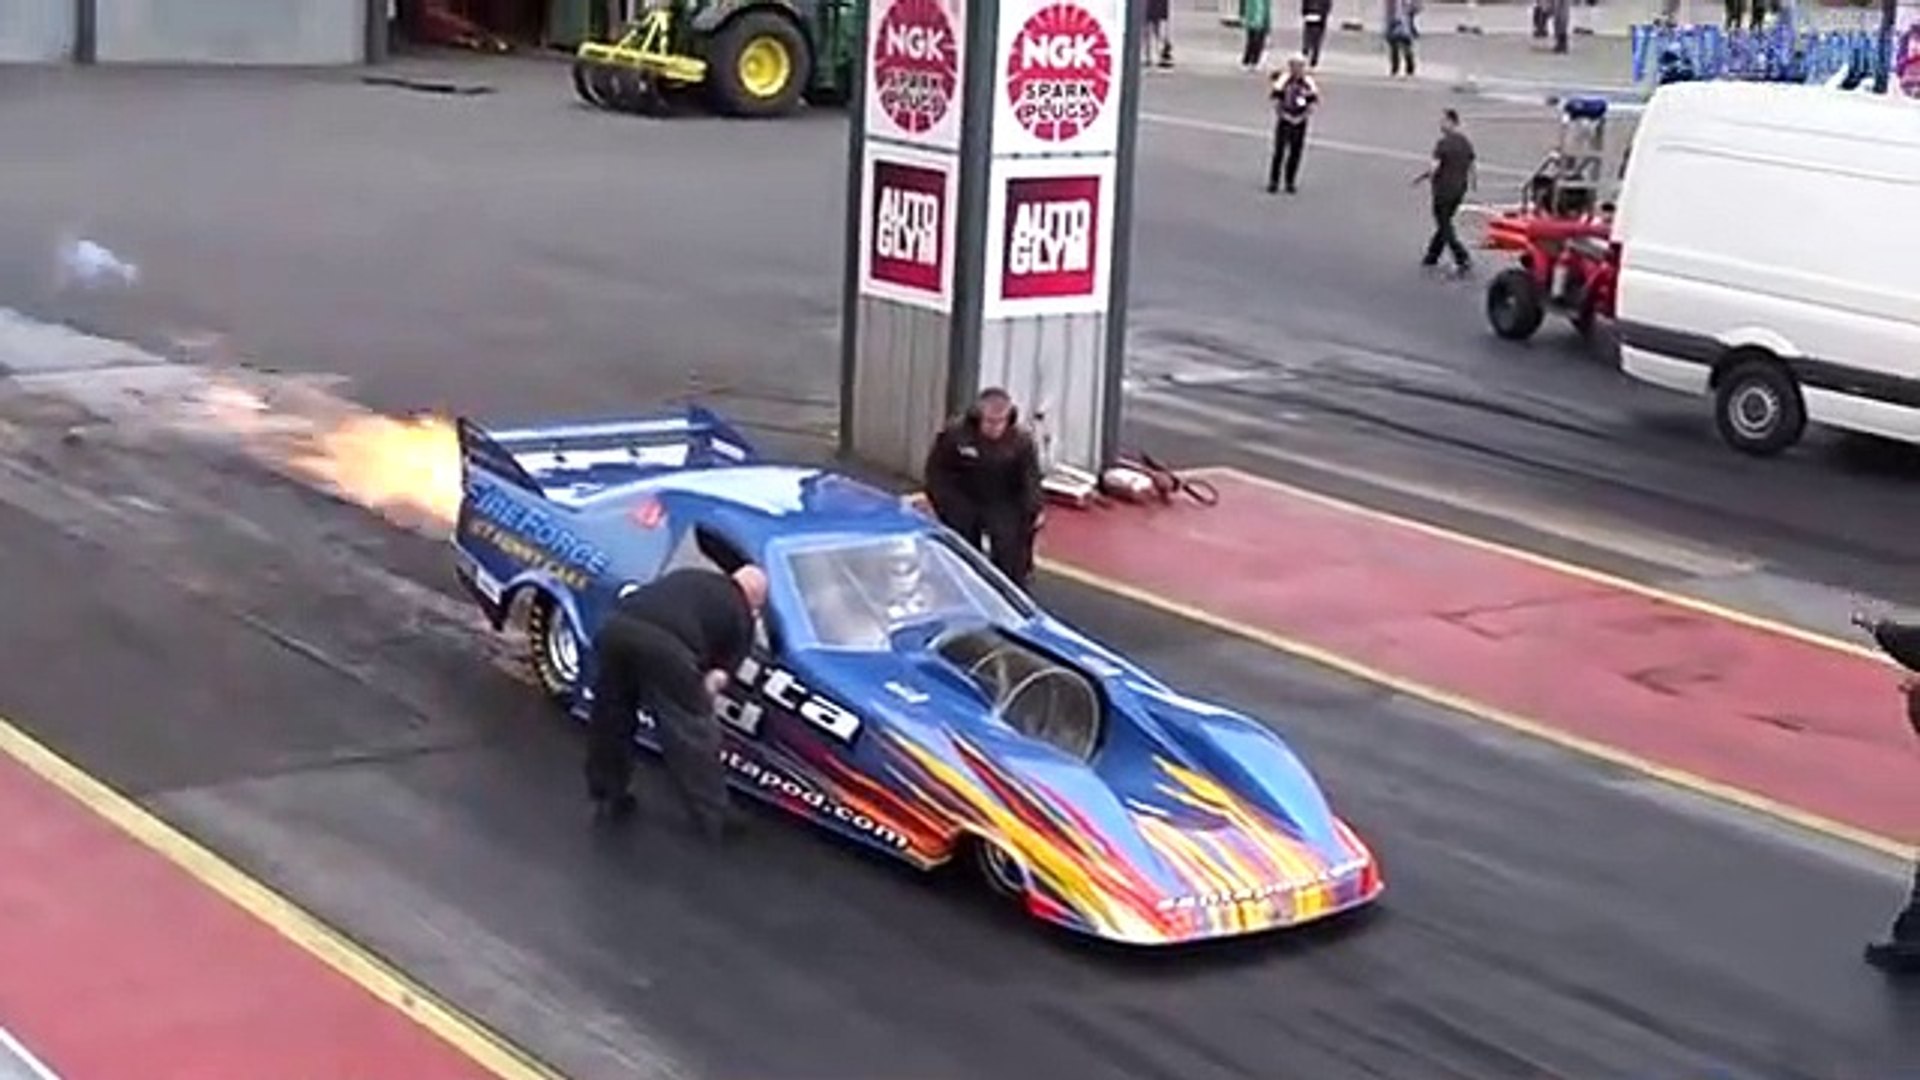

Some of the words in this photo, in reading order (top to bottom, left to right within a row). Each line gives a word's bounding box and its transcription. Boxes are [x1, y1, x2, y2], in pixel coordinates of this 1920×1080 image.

[886, 24, 945, 61] NGK
[1021, 34, 1098, 69] NGK
[1024, 103, 1093, 121] PLUGS
[1025, 82, 1092, 101] SPARK
[879, 186, 938, 229] AUTO
[1015, 200, 1092, 242] AUTO
[876, 222, 938, 267] GLYM
[1010, 232, 1090, 274] GLYM
[719, 749, 909, 849] tapod.com
